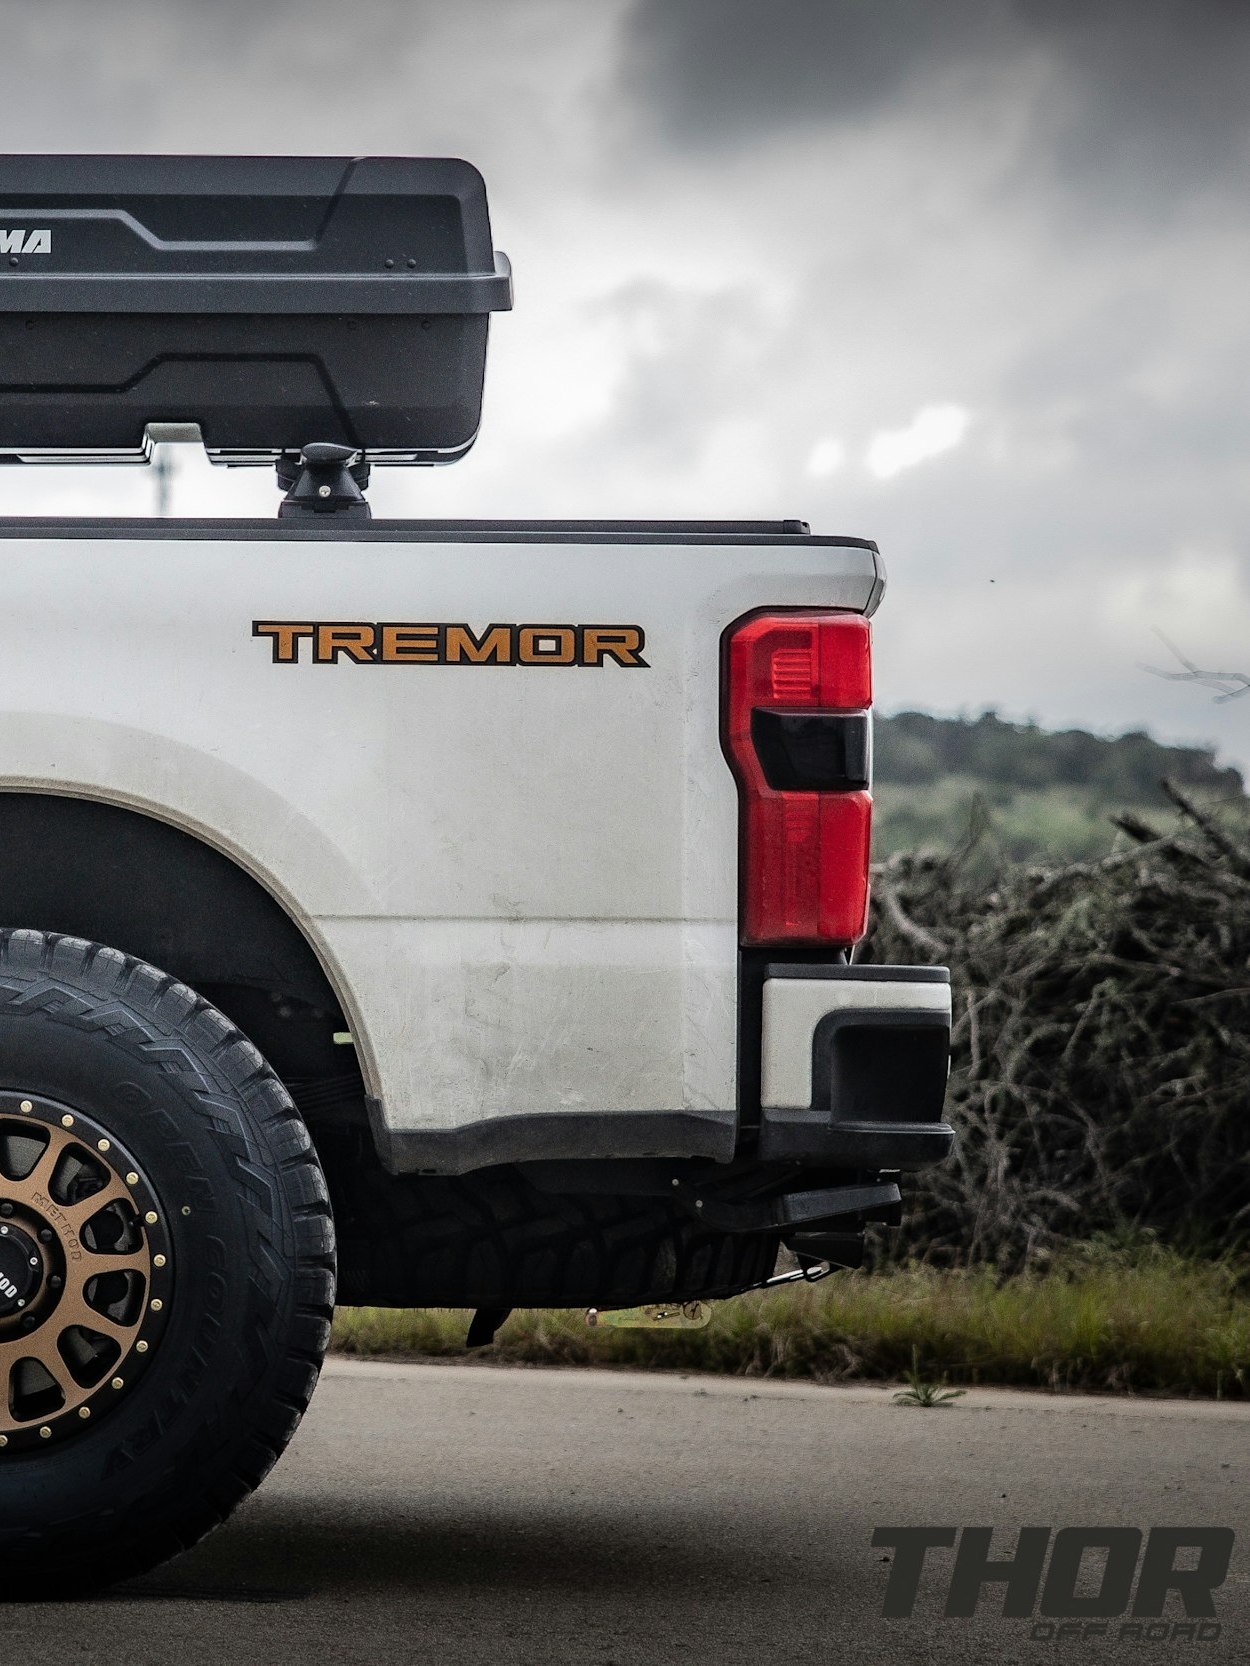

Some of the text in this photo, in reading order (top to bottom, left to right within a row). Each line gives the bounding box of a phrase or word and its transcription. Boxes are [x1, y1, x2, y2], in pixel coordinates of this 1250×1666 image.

[252, 620, 651, 668] TREMOR
[116, 1081, 216, 1214] OPEN
[31, 1191, 81, 1261] METHOD
